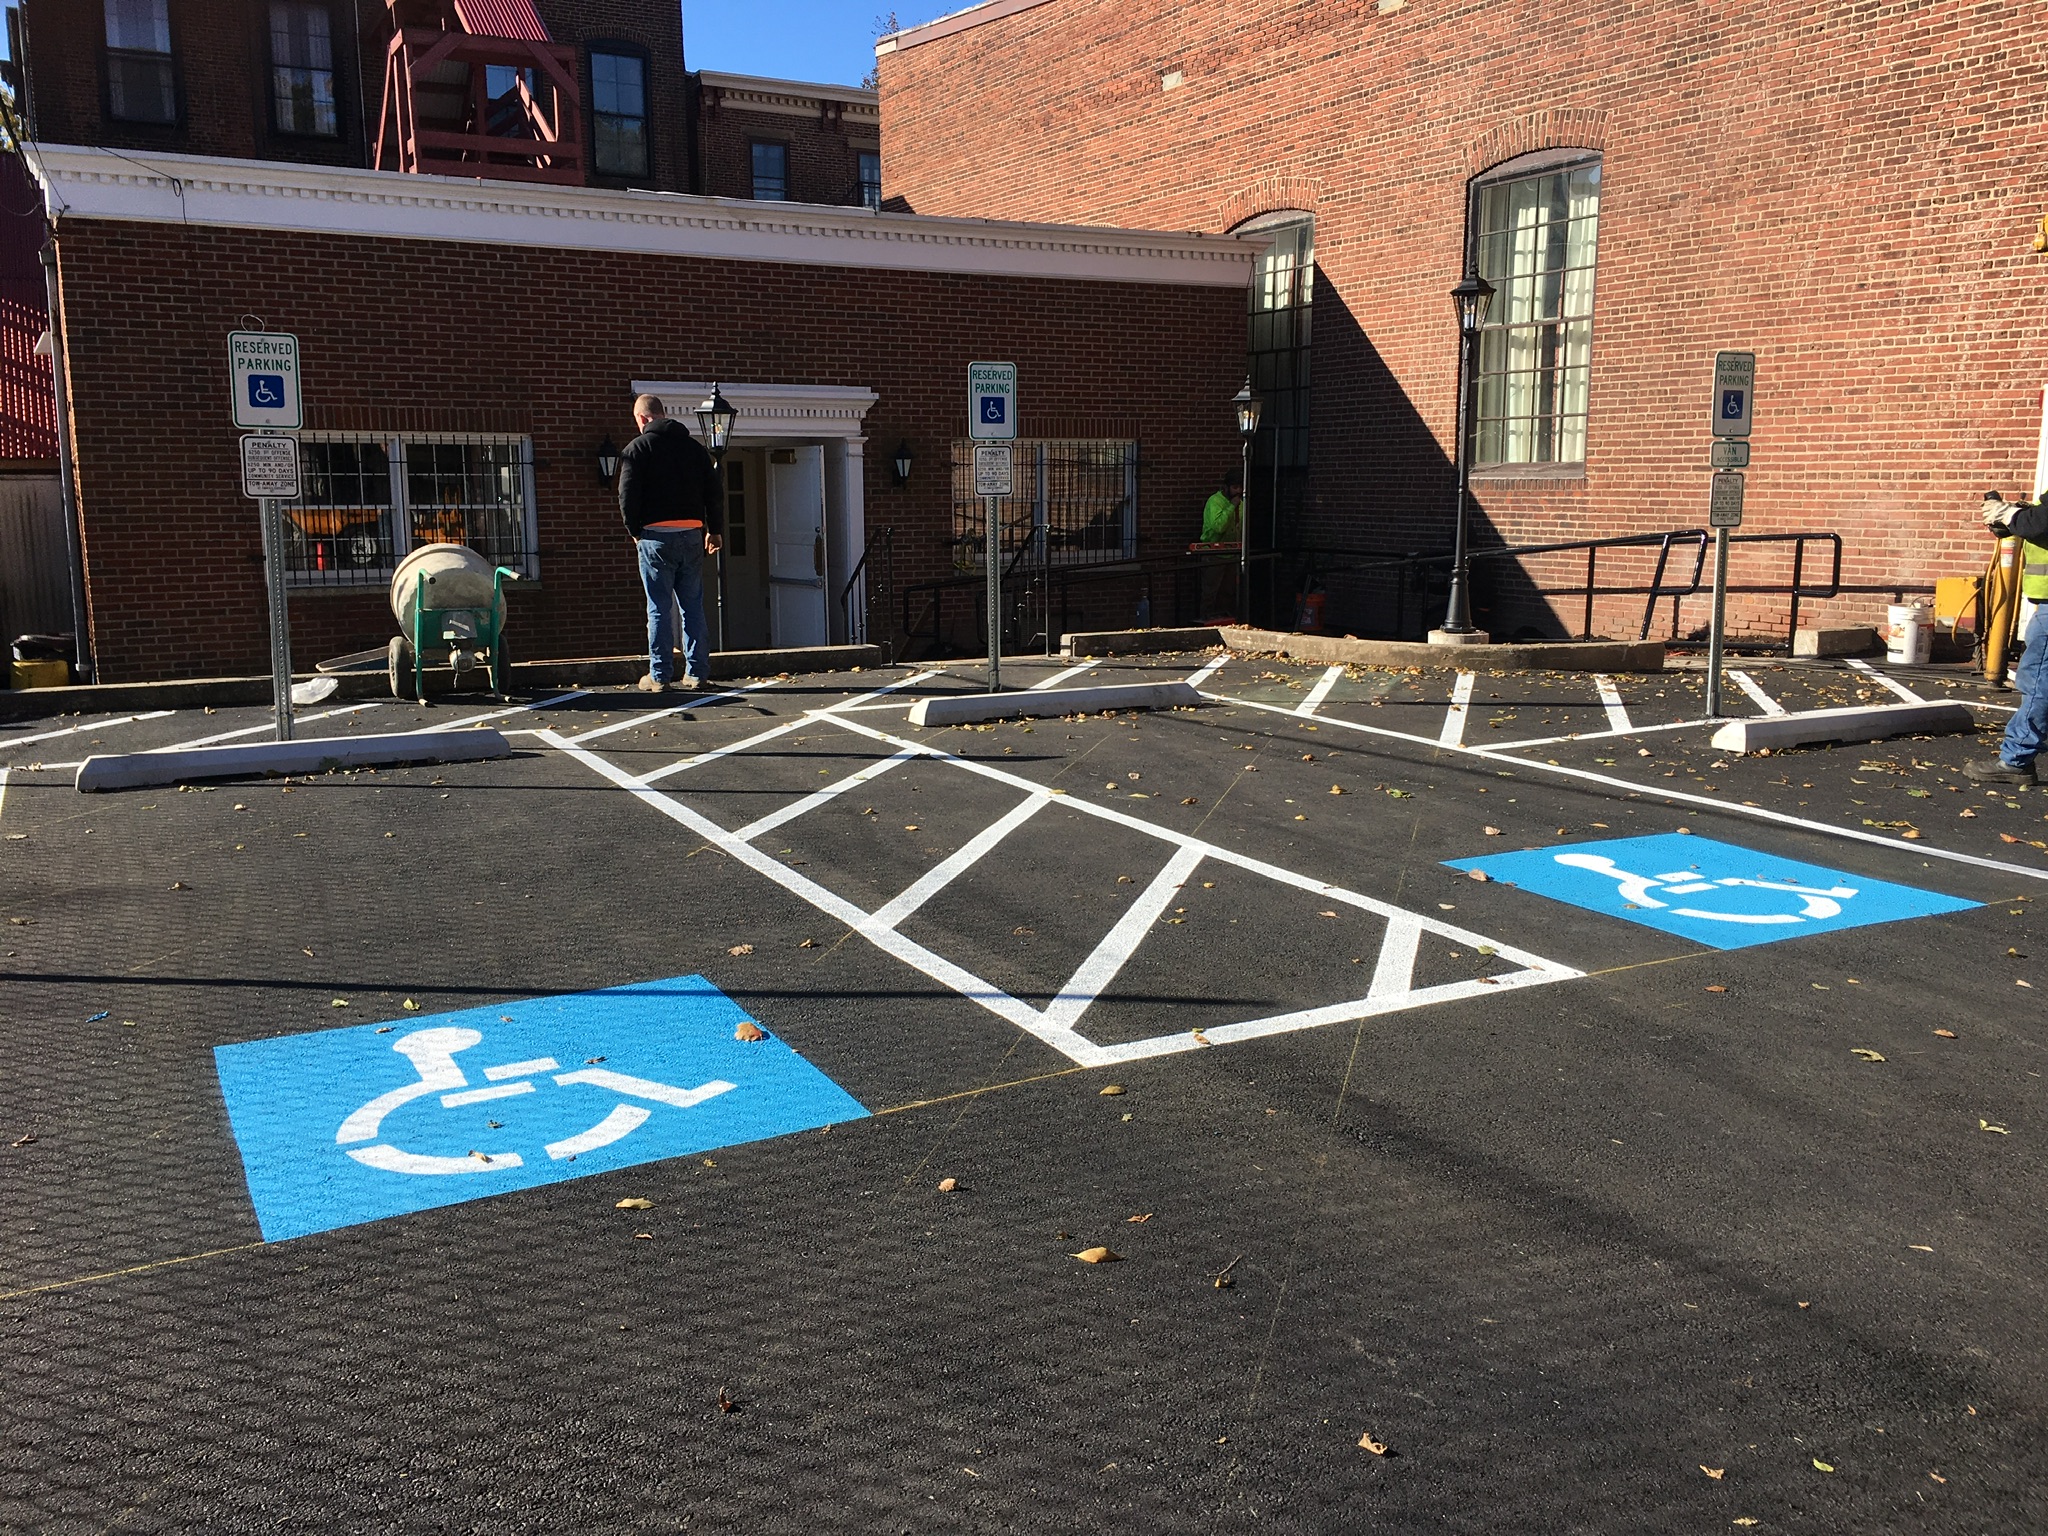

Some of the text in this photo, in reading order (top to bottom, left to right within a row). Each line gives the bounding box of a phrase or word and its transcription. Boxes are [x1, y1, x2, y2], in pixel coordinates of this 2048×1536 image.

[234, 341, 292, 355] RESERVED
[238, 357, 291, 371] PARKING
[1718, 361, 1752, 372] RESERVED
[972, 370, 1012, 380] RESERVED
[1719, 375, 1750, 386] PARKING
[975, 383, 1010, 394] PARKING
[1723, 447, 1737, 456] VAN
